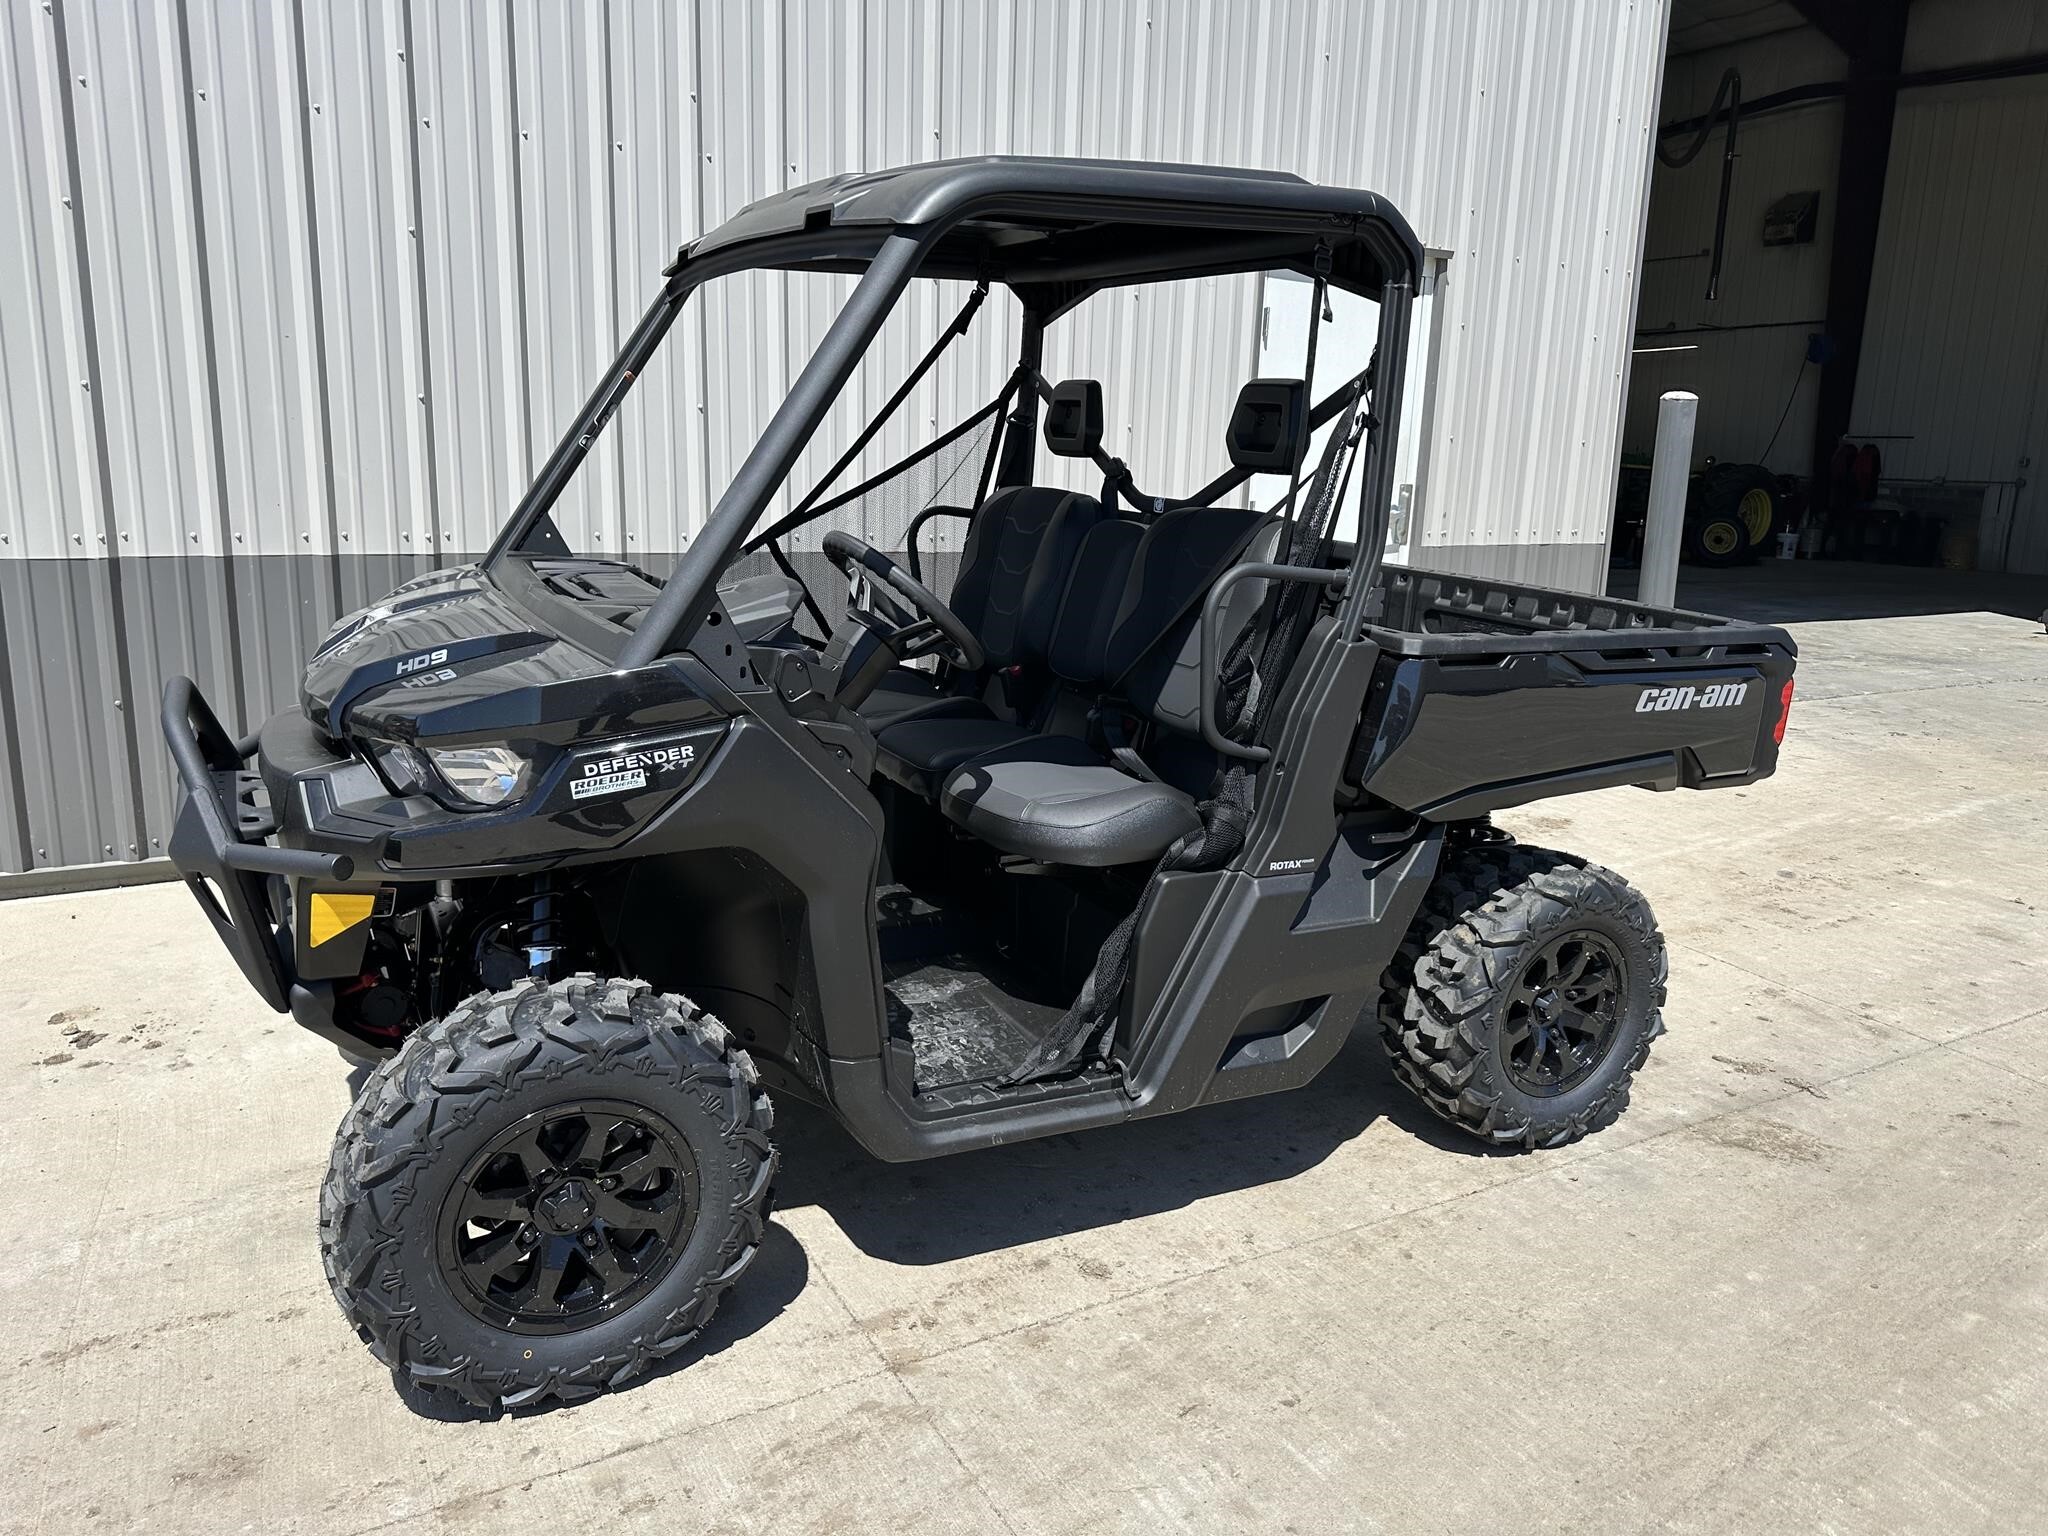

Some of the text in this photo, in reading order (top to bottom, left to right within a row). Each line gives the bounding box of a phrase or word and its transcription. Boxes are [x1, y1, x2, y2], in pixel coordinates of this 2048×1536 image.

[396, 649, 448, 675] HD9
[1635, 683, 1747, 712] can-am
[584, 745, 695, 777] DEFENDER
[659, 757, 694, 773] XT
[574, 771, 642, 790] ROEDER
[591, 780, 639, 792] BROTHERS
[1269, 859, 1302, 871] ROTAX
